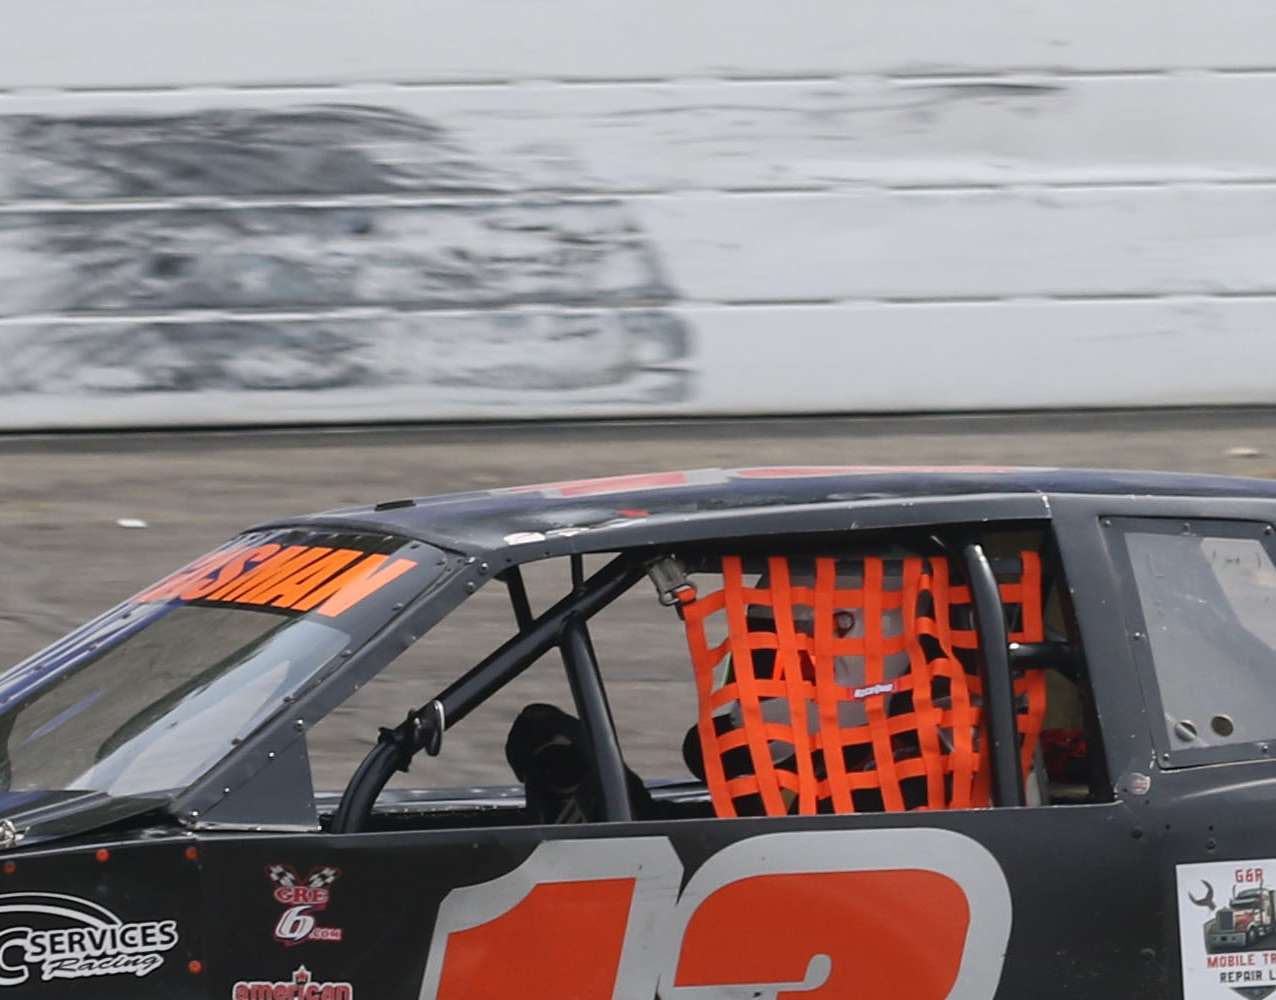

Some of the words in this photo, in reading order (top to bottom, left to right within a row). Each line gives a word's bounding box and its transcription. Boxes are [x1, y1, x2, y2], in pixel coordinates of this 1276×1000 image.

[1235, 868, 1264, 883] G&R
[27, 921, 178, 963] SERVICES
[41, 953, 165, 981] Racing
[1206, 954, 1256, 968] MOBILE
[1219, 970, 1263, 983] REPAIR
